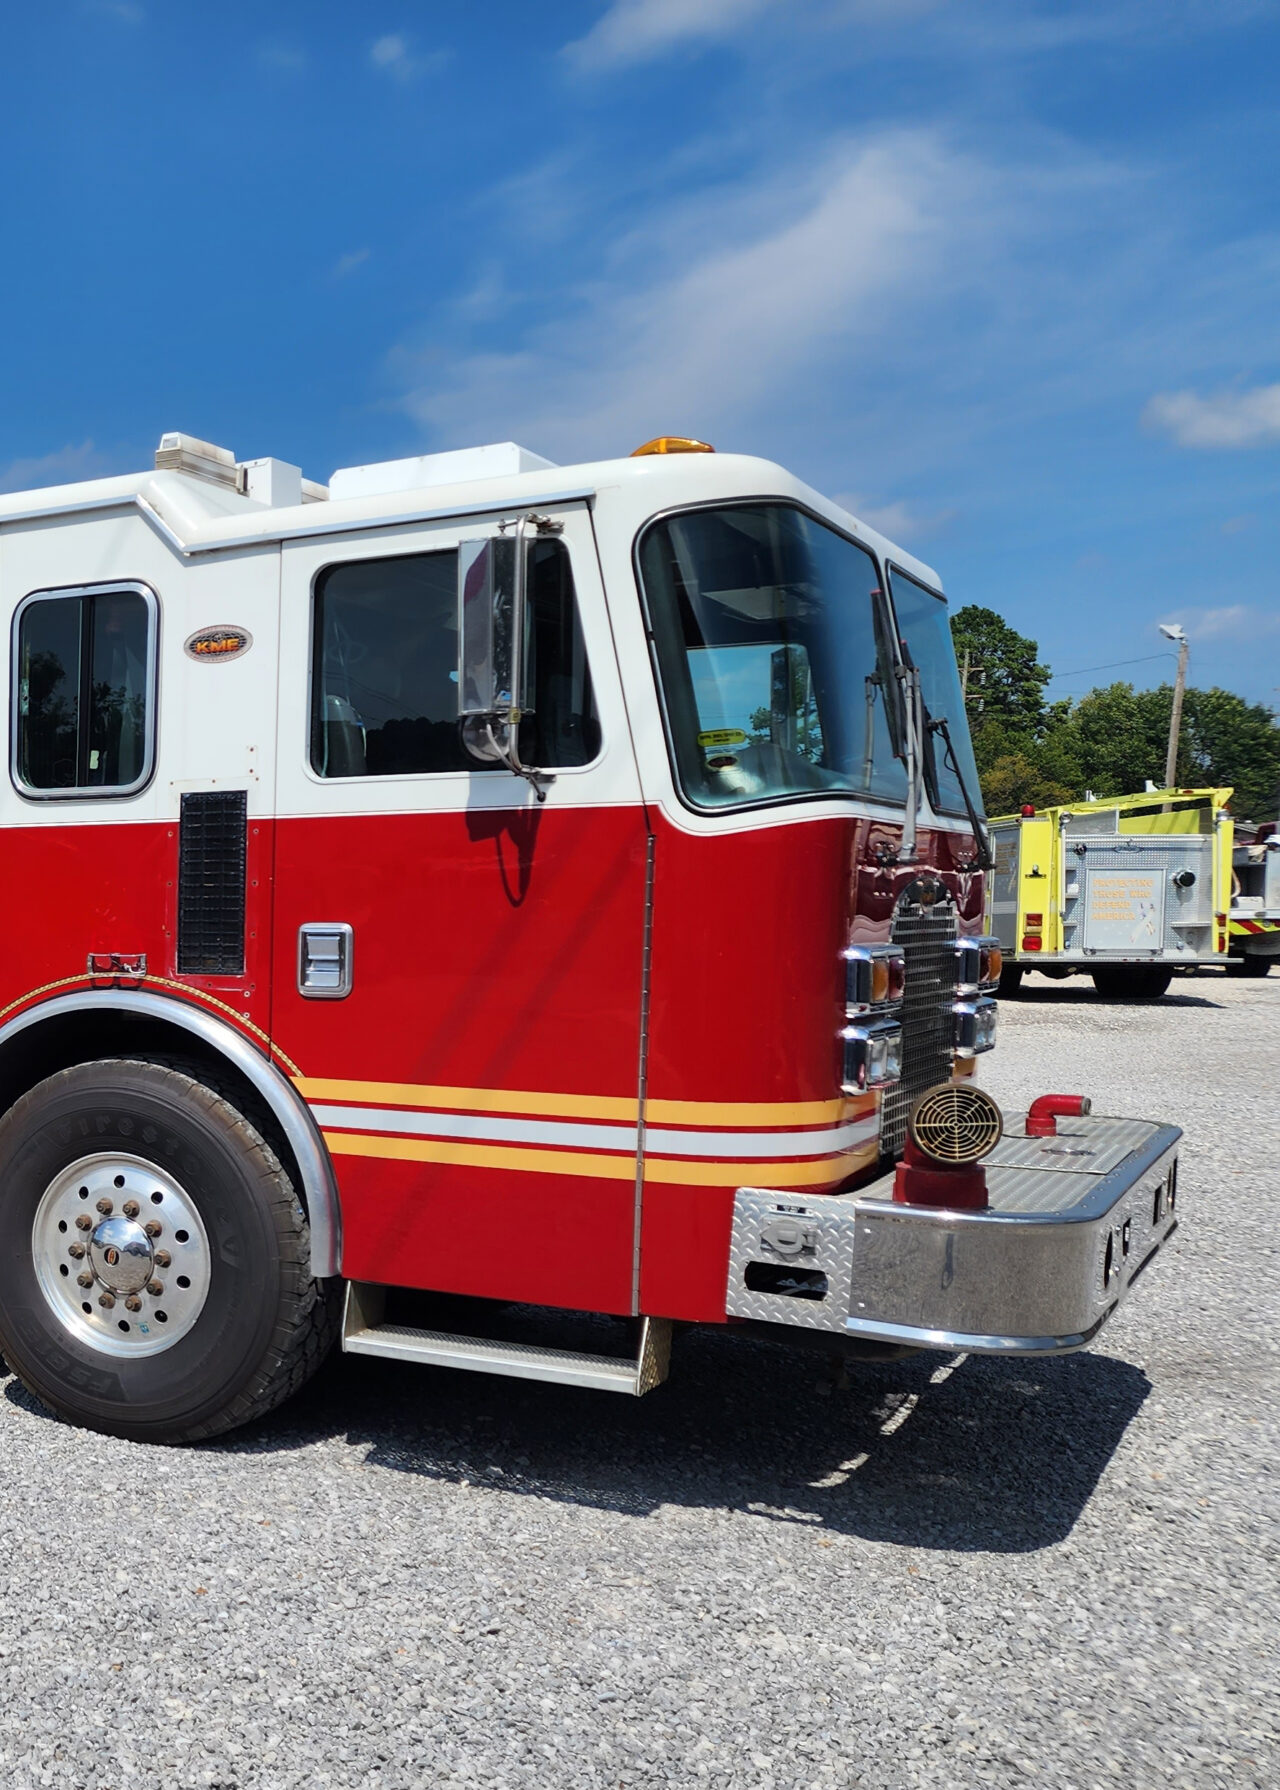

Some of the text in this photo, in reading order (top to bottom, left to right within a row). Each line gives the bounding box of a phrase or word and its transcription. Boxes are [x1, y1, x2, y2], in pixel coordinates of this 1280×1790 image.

[196, 638, 239, 654] KME
[1092, 878, 1155, 887] PROTECTING
[1093, 890, 1151, 898] THOSE WHO
[1092, 901, 1131, 909] DEFEND
[1091, 912, 1135, 920] AMERICA
